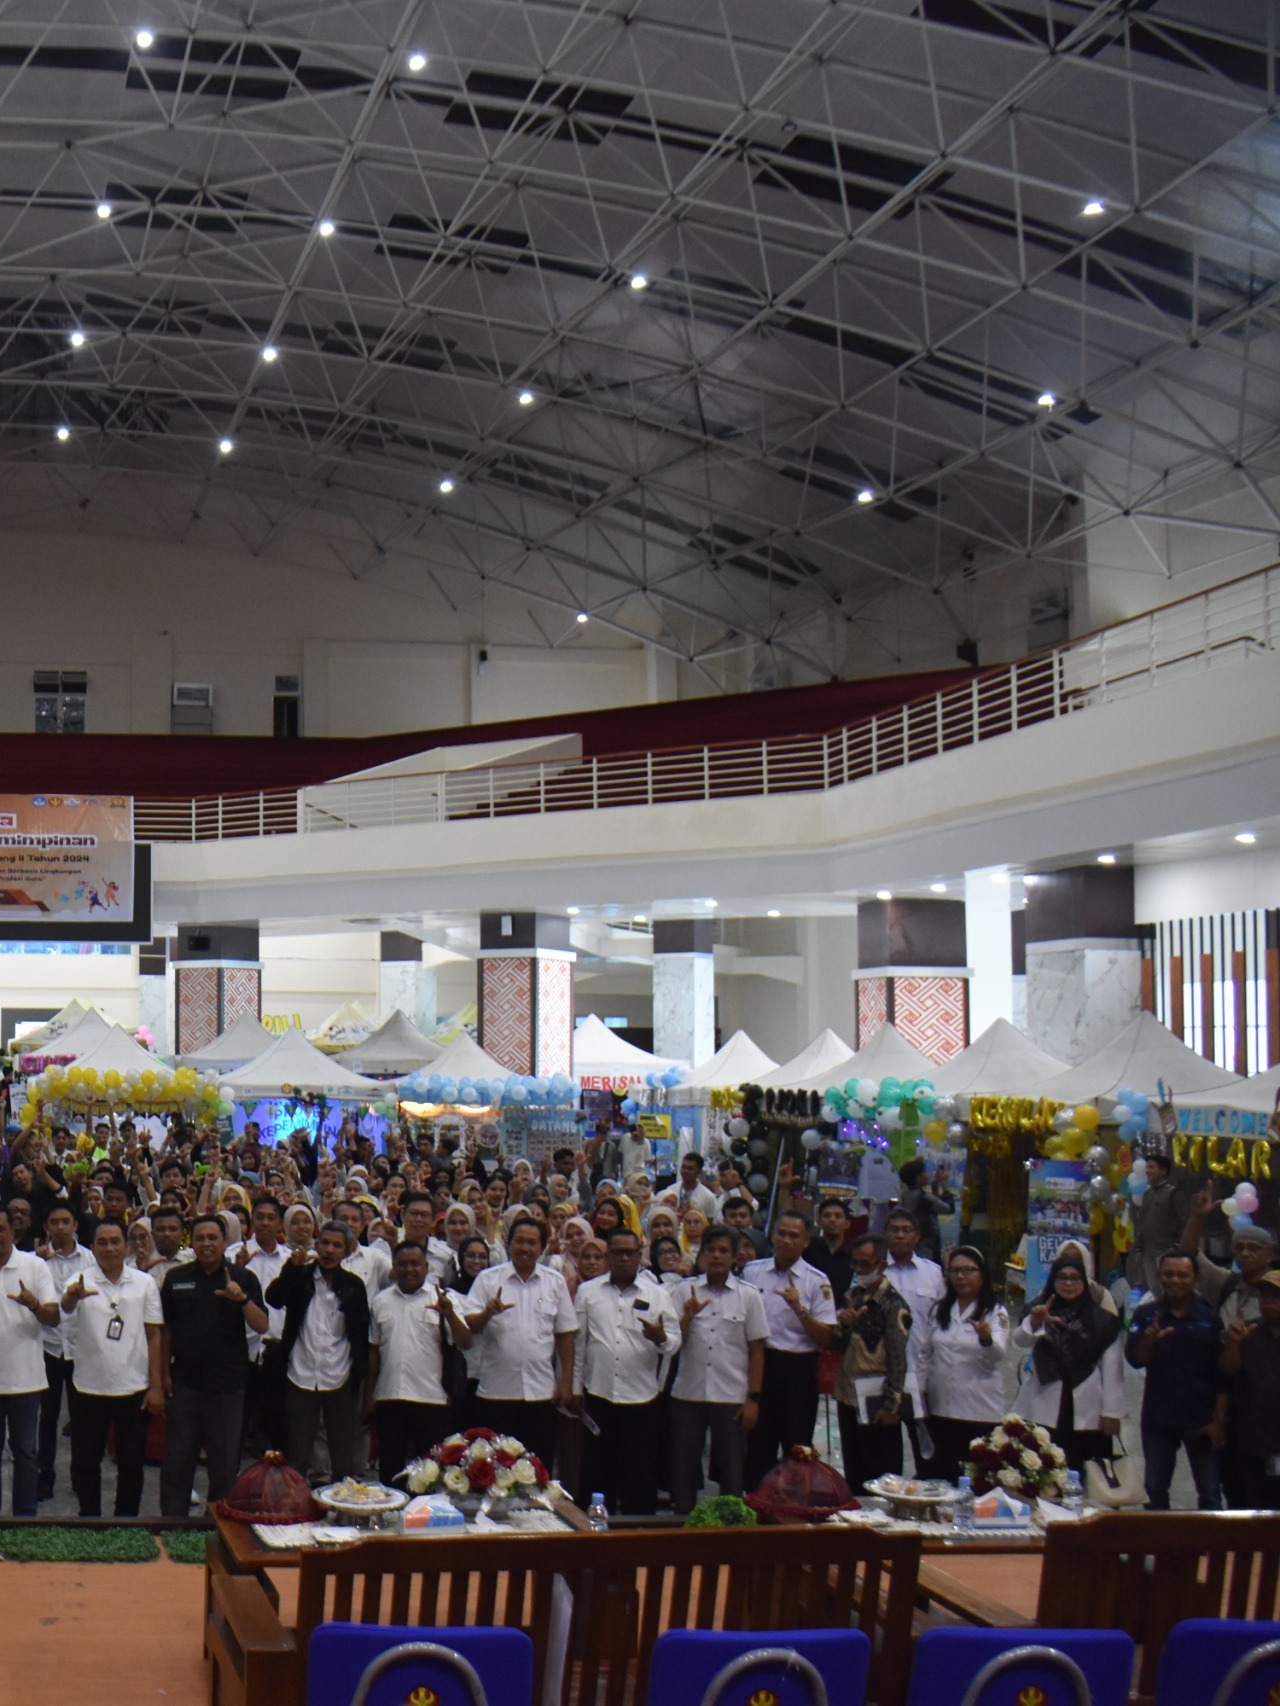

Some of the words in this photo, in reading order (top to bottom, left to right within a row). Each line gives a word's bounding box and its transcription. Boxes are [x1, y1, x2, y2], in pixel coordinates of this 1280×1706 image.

[28, 854, 60, 863] Tahun
[62, 854, 90, 863] 2024
[1178, 1107, 1268, 1136] WELCOME
[1171, 1134, 1272, 1182] PILAR
